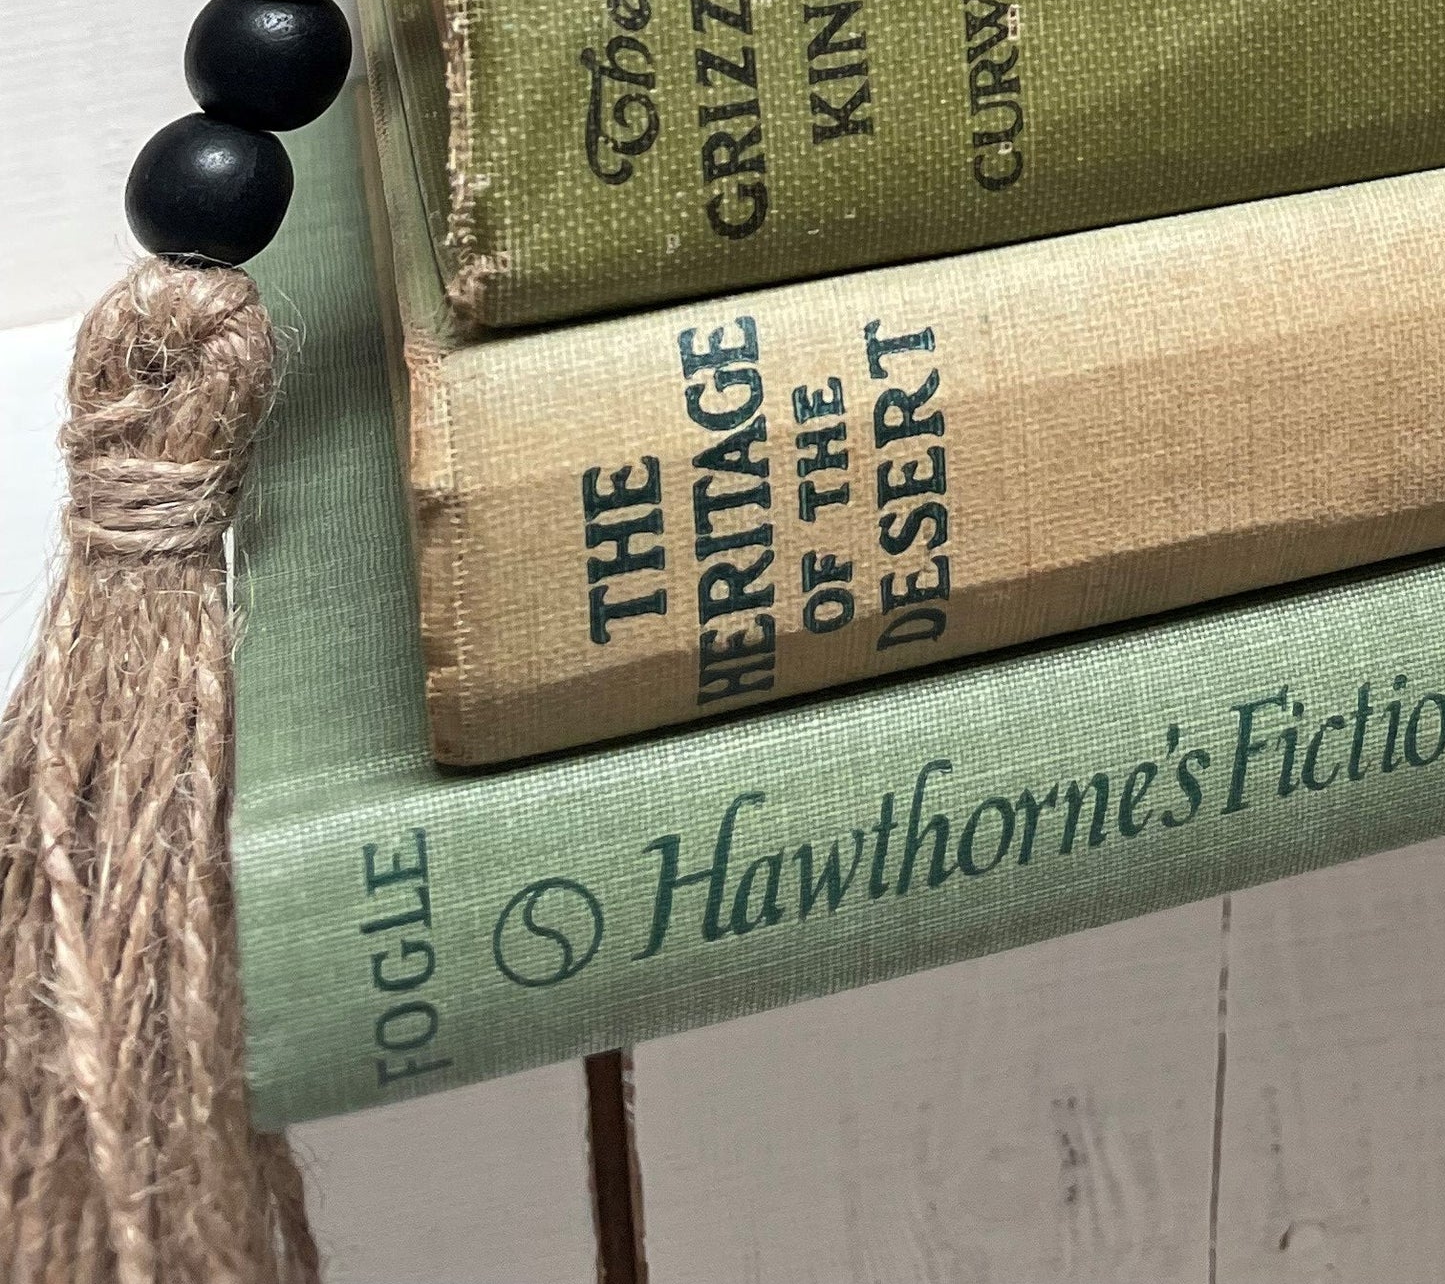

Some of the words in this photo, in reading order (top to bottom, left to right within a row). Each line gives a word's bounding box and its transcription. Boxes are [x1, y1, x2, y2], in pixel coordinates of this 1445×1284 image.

[582, 454, 668, 644] THE
[679, 315, 776, 707] HERITAGE
[792, 375, 851, 523] THE
[863, 318, 951, 652] DESERT
[802, 550, 856, 633] OF
[358, 826, 454, 1090] FOGLE
[629, 721, 1212, 961] Hawthorne's
